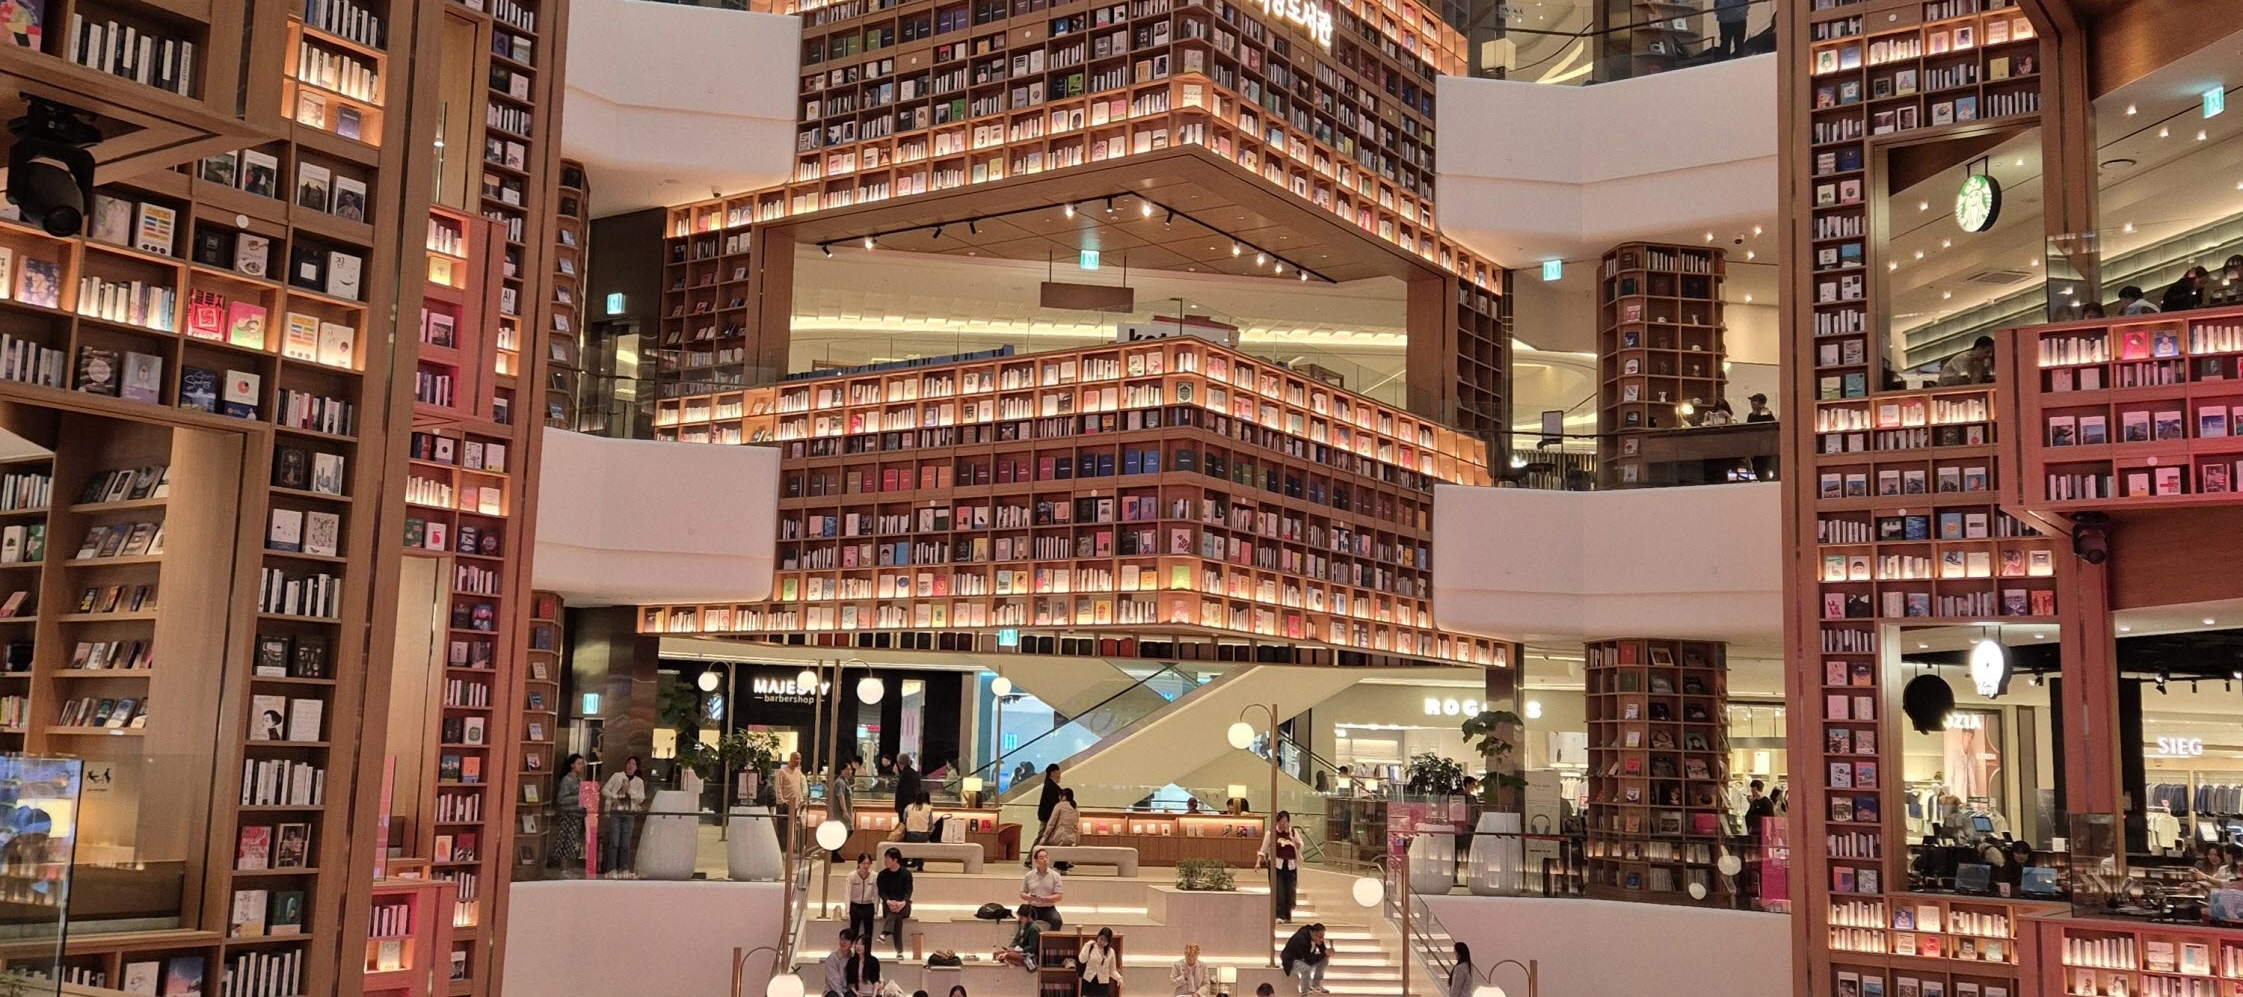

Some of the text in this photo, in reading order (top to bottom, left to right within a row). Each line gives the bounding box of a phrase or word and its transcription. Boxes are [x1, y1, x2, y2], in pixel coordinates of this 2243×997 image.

[1262, 0, 1333, 47] 도서관
[764, 694, 815, 705] barbershop
[1424, 698, 1542, 719] ROGS
[2158, 737, 2203, 755] SIEG
